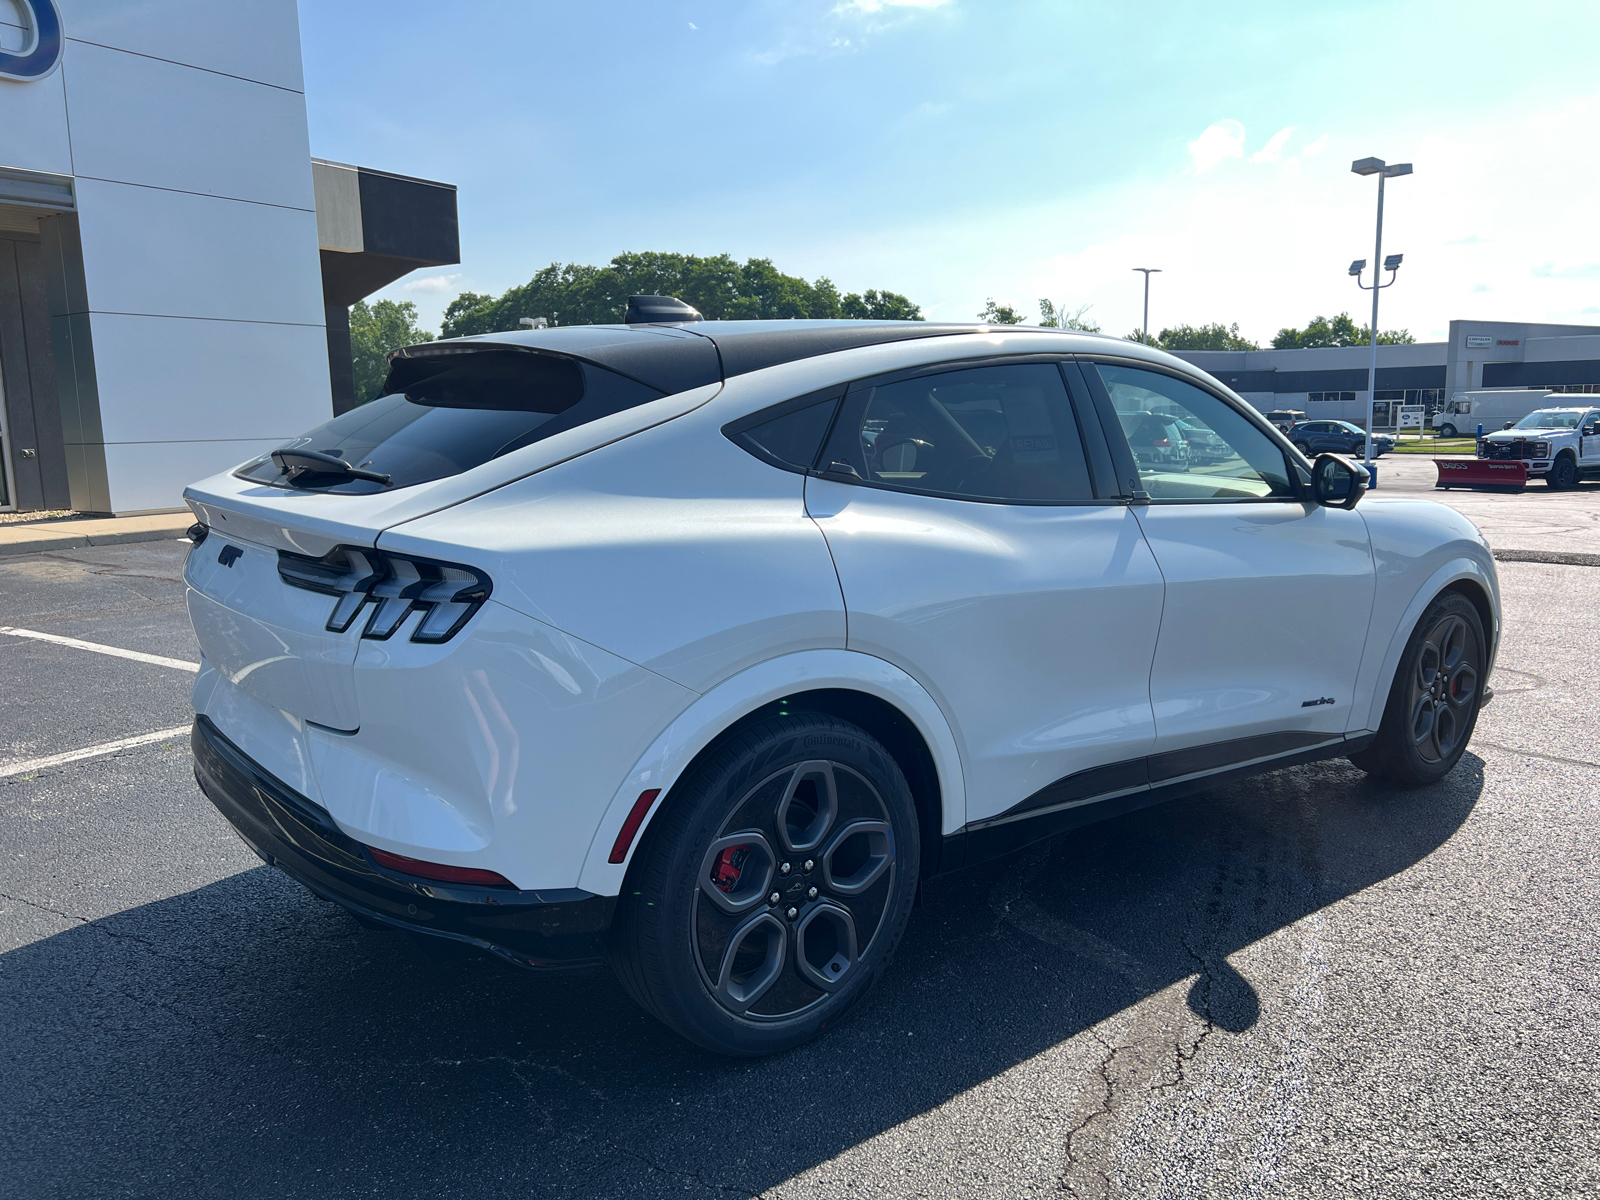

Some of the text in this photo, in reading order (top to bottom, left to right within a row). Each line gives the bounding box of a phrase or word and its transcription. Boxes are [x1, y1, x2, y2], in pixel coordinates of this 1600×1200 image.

[1017, 438, 1052, 450] RETAIL
[1441, 462, 1468, 470] BOSS
[218, 544, 244, 569] GT
[803, 734, 855, 750] Continental
